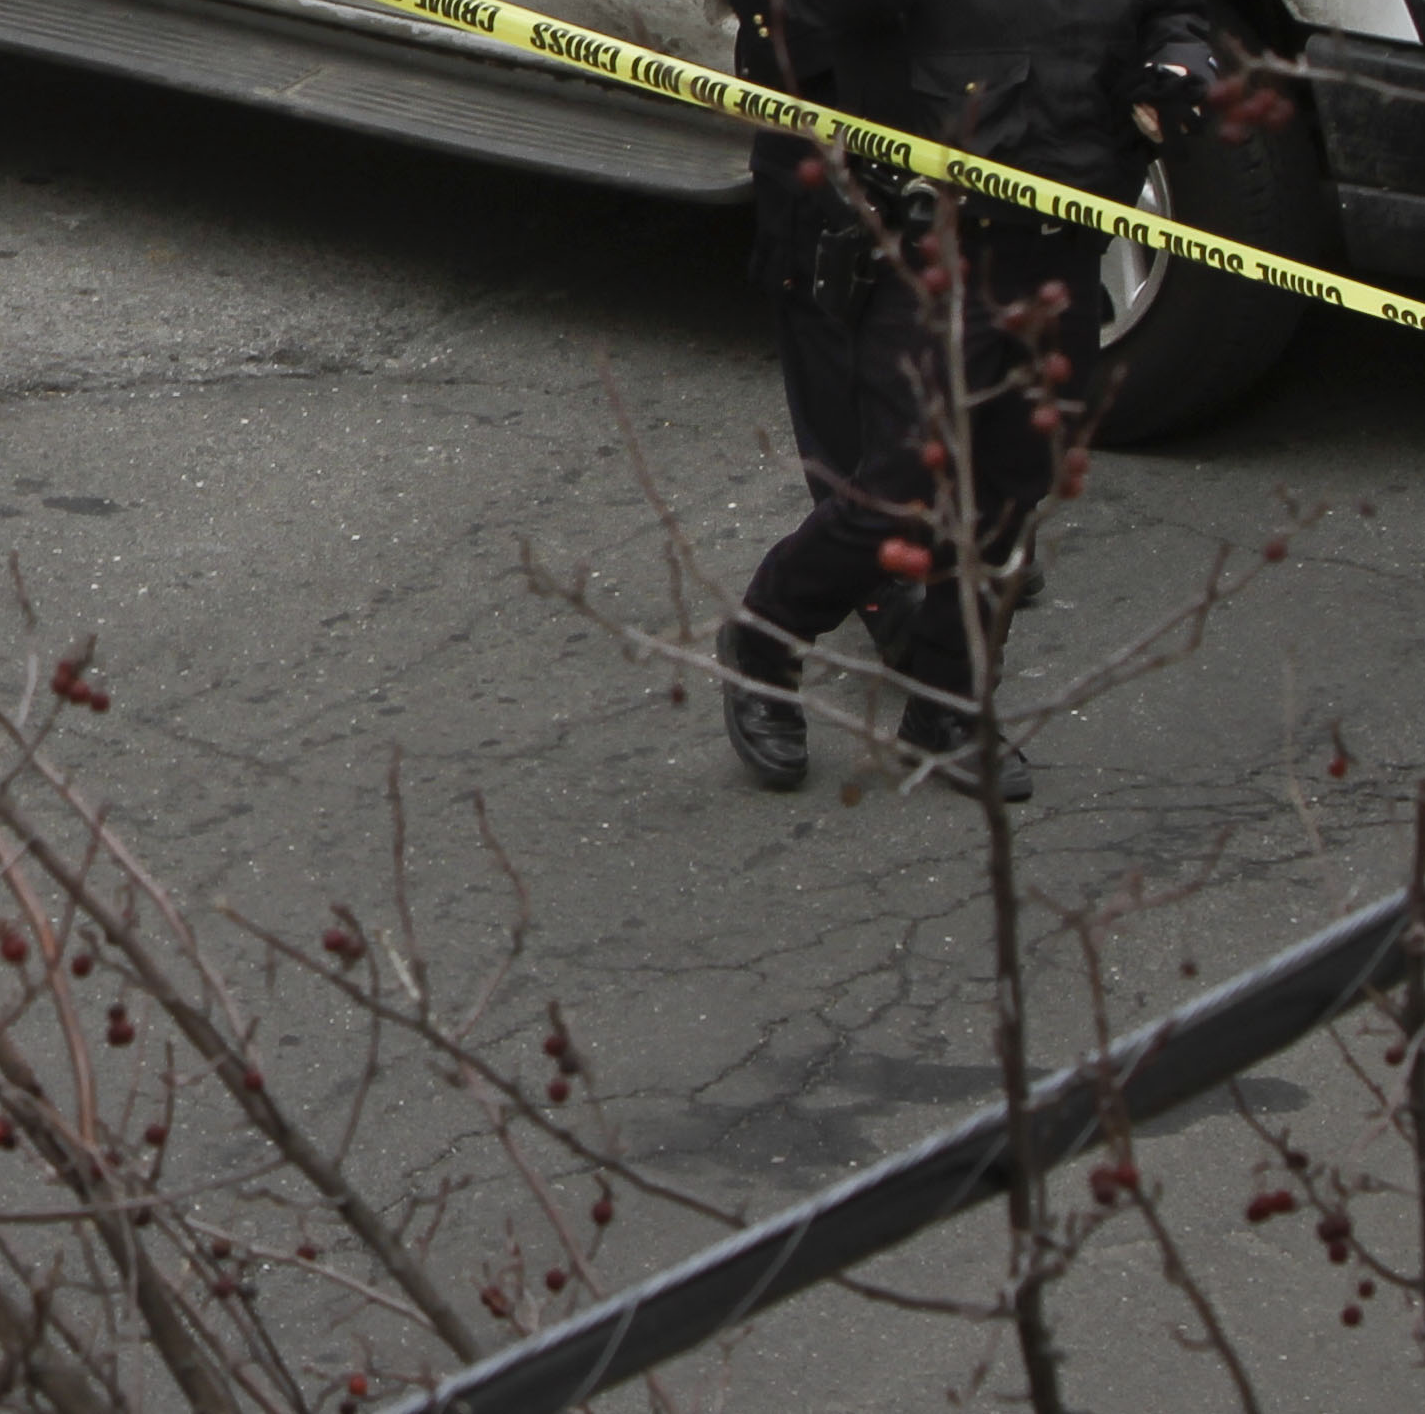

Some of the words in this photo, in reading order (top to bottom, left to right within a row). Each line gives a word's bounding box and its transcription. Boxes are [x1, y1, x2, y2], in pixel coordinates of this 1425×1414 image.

[530, 21, 622, 74] CROSS
[631, 54, 685, 95] NOT
[689, 75, 730, 106] DO
